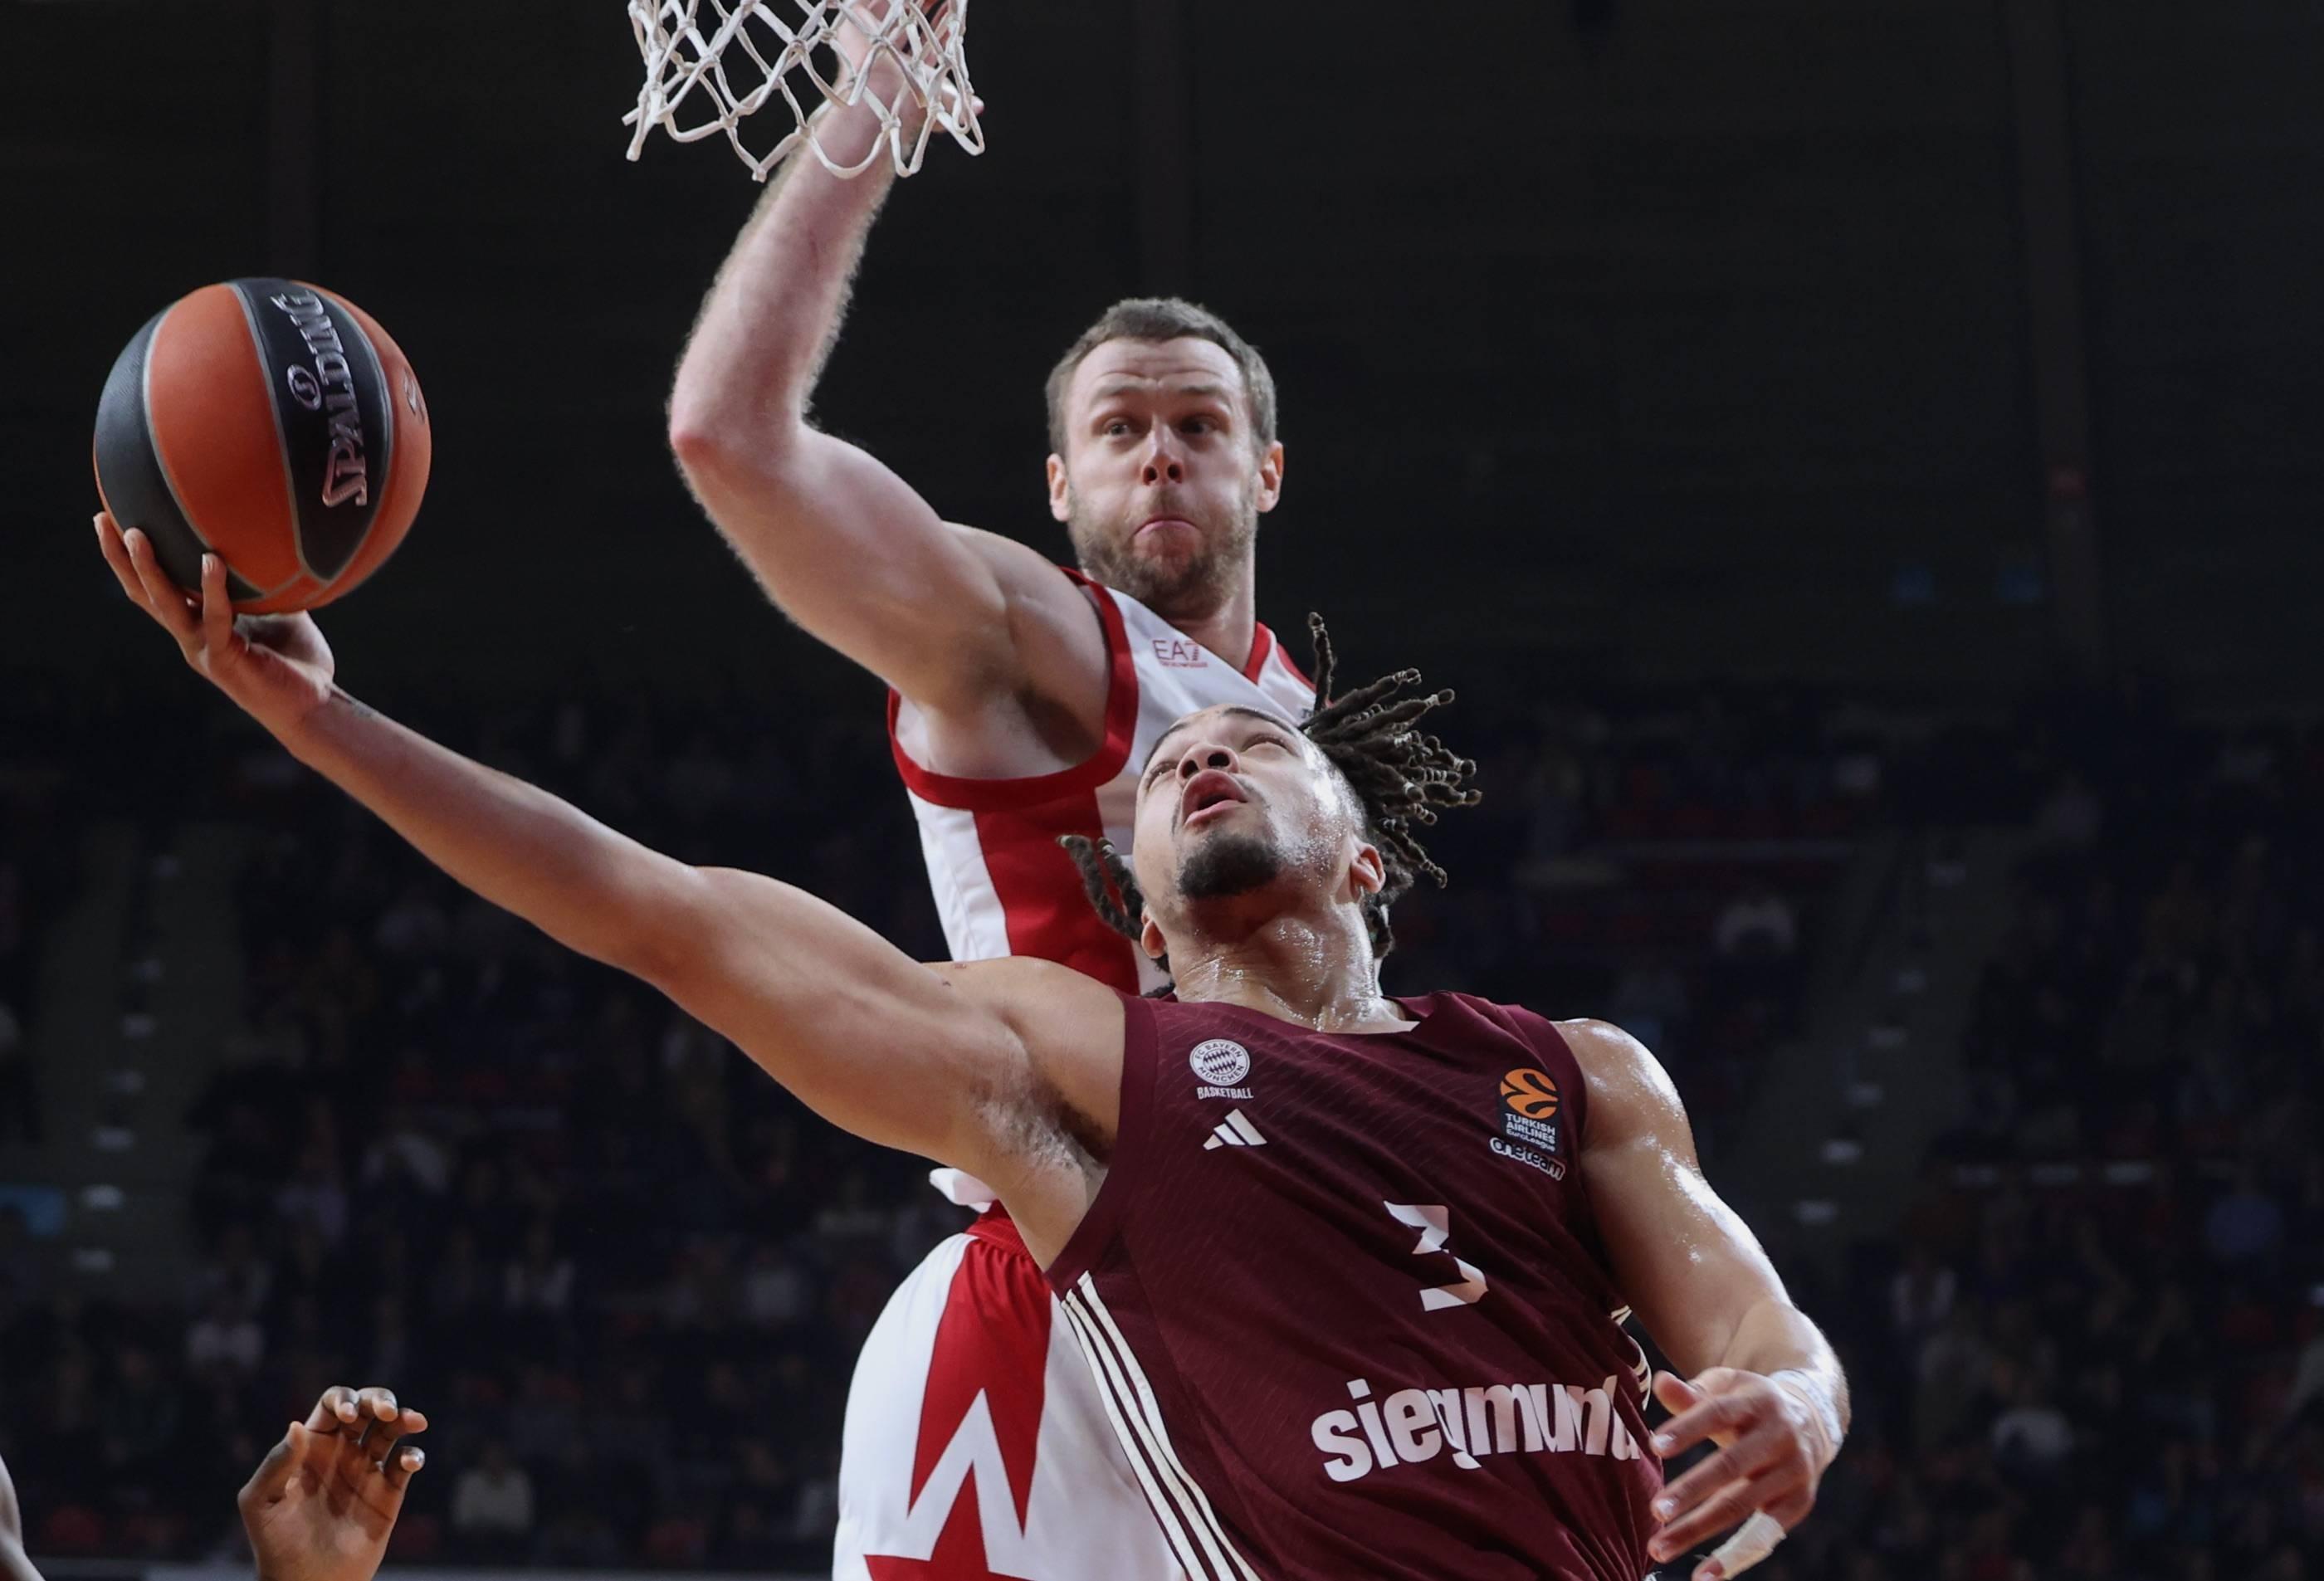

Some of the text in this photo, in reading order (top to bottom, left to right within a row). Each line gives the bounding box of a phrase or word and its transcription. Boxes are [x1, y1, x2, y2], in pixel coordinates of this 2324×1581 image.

[271, 290, 368, 508] SPALDING
[1152, 639, 1199, 661] EA7
[1204, 1042, 1243, 1057] BAYERN
[1196, 1086, 1254, 1100] BASKETBALL
[1505, 1113, 1555, 1136] TURKISH
[1506, 1121, 1555, 1144] AIRLINES
[1384, 1200, 1489, 1312] 3
